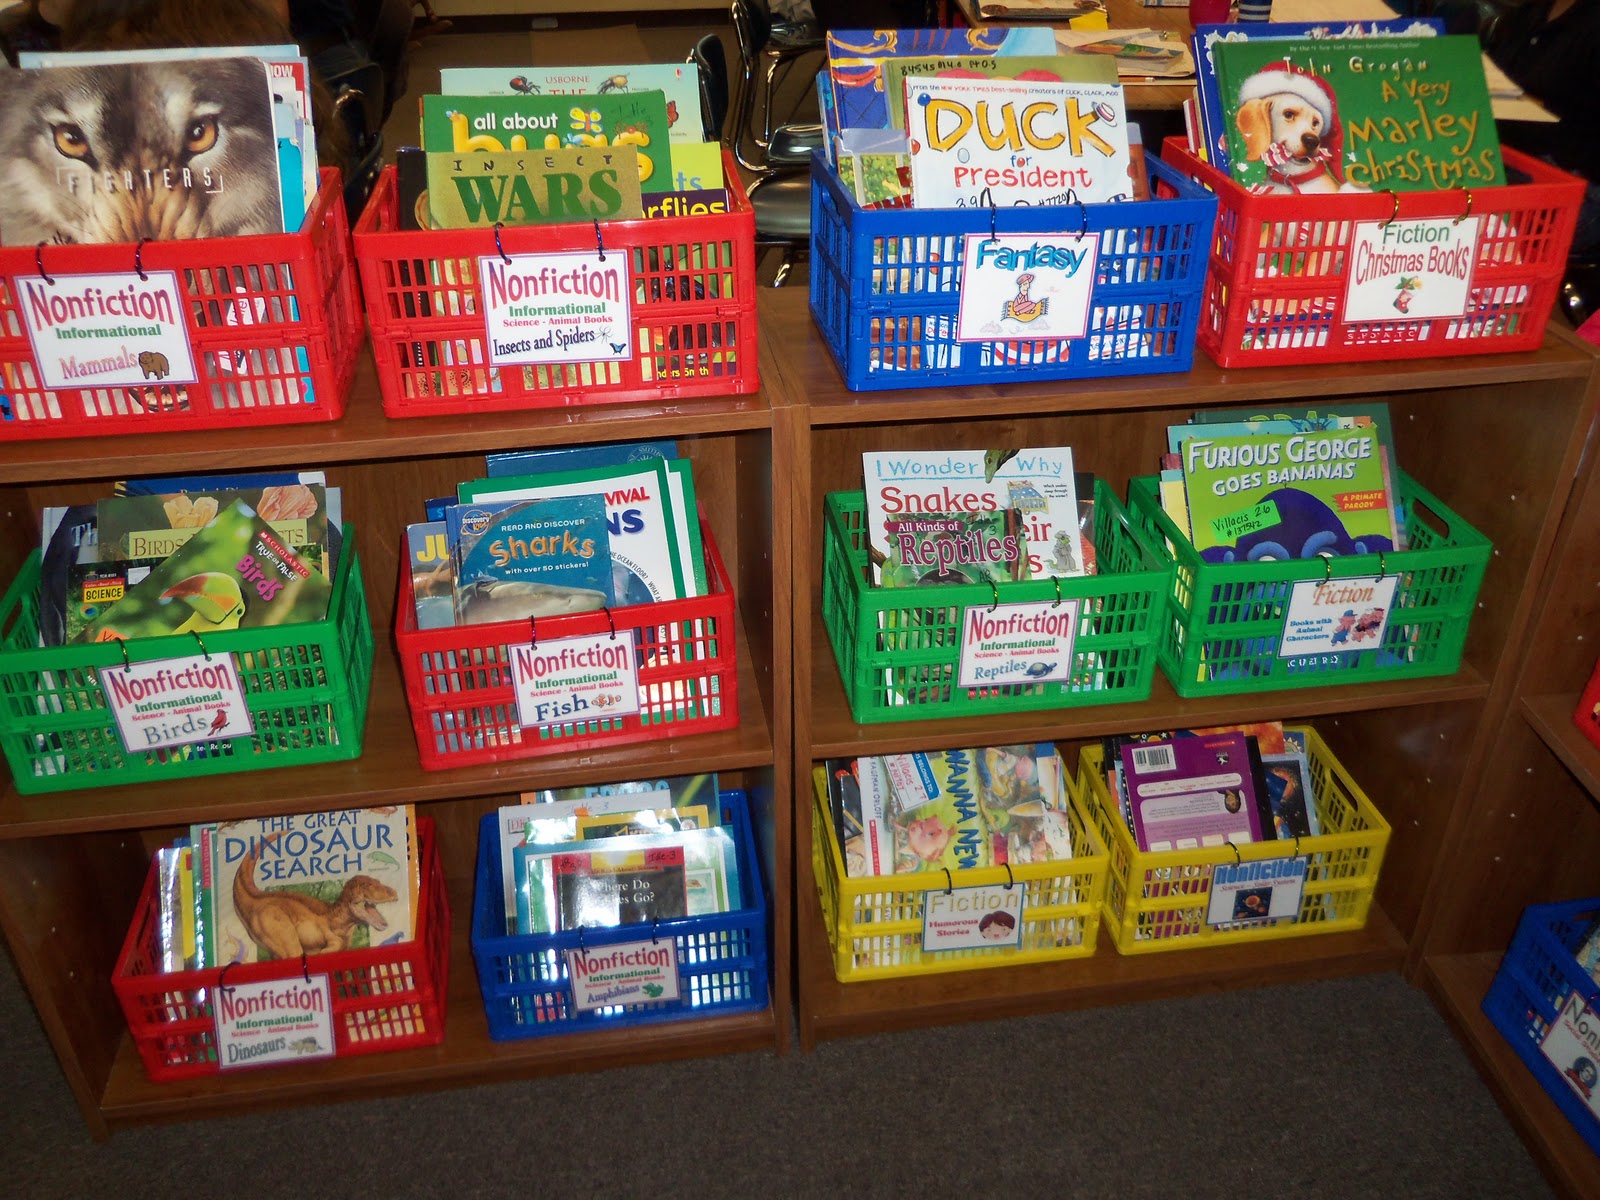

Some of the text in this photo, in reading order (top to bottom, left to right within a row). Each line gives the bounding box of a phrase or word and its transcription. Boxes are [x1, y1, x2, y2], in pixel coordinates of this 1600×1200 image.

[545, 75, 590, 85] USBORNE
[1349, 56, 1428, 80] Grogan
[1381, 80, 1451, 105] A Very
[474, 113, 559, 132] all about
[1349, 100, 1478, 156] Marley
[452, 153, 614, 172] INSECT
[1010, 154, 1033, 168] for
[67, 167, 213, 194] FIGHTERS
[954, 165, 1094, 190] President
[450, 168, 624, 223] WARS
[1382, 223, 1450, 245] Fiction
[976, 240, 1088, 278] Fantasy
[1355, 239, 1469, 286] Christmas Books
[488, 261, 620, 310] Nonfiction
[25, 280, 176, 333] Nonfiction
[509, 302, 606, 317] Informational
[55, 323, 163, 341] Informational
[503, 315, 613, 327] Science Animal Books
[493, 325, 595, 356] Insects and Spiders
[58, 346, 138, 380] Mammals
[876, 455, 1063, 478] I Wonder Why
[1189, 436, 1373, 473] FURIOUS GEORGE
[1212, 462, 1357, 496] GOES BANANAS
[605, 486, 650, 508] VIVAL
[880, 486, 998, 514] Snakes
[1344, 500, 1374, 510] PARODY
[1350, 492, 1383, 501] PRIMATE
[525, 522, 543, 530] AND
[543, 519, 586, 529] DISCOVER
[898, 520, 959, 532] All Kinds of
[133, 536, 185, 557] BIRDS
[266, 537, 309, 578] SCHOLASTIC
[489, 530, 596, 567] Sharks
[899, 530, 1020, 577] Reptiles
[255, 540, 274, 560] TRUE
[276, 560, 298, 582] FALSE
[555, 562, 590, 571] stickers!
[617, 553, 633, 568] OCEAN
[632, 563, 649, 580] FLOOR?
[236, 554, 285, 602] Birds
[85, 587, 122, 601] SCIENCE
[1312, 581, 1375, 606] Fiction
[968, 609, 1070, 645] Nonfiction
[980, 637, 1056, 651] Informational
[516, 643, 629, 685] Nonfiction
[974, 659, 1027, 680] Reptiles
[107, 663, 234, 709] Nonfiction
[530, 681, 624, 697] Science Animal Books
[535, 670, 618, 689] Informational
[132, 701, 231, 721] Science Animal Books
[135, 691, 223, 713] Informational
[534, 693, 589, 722] Fish
[143, 713, 209, 745] Birds
[870, 761, 882, 819] KAUFMAN ORLOFF
[257, 810, 361, 833] THE GREAT
[225, 824, 394, 863] DINOSAUR
[259, 852, 363, 881] SEARCH
[1215, 860, 1305, 885] Nonfiction
[633, 878, 650, 890] Do
[633, 891, 655, 902] Go?
[929, 889, 1018, 914] Fiction
[929, 918, 979, 928] Humorous
[936, 928, 970, 937] Stories
[573, 947, 670, 979] Nonfiction
[589, 967, 661, 982] Informational
[220, 985, 324, 1025] Nonfiction
[588, 984, 640, 1003] Amphibians
[236, 1012, 314, 1030] Informational
[267, 1025, 294, 1033] Animal
[227, 1037, 286, 1063] Dinosaurs
